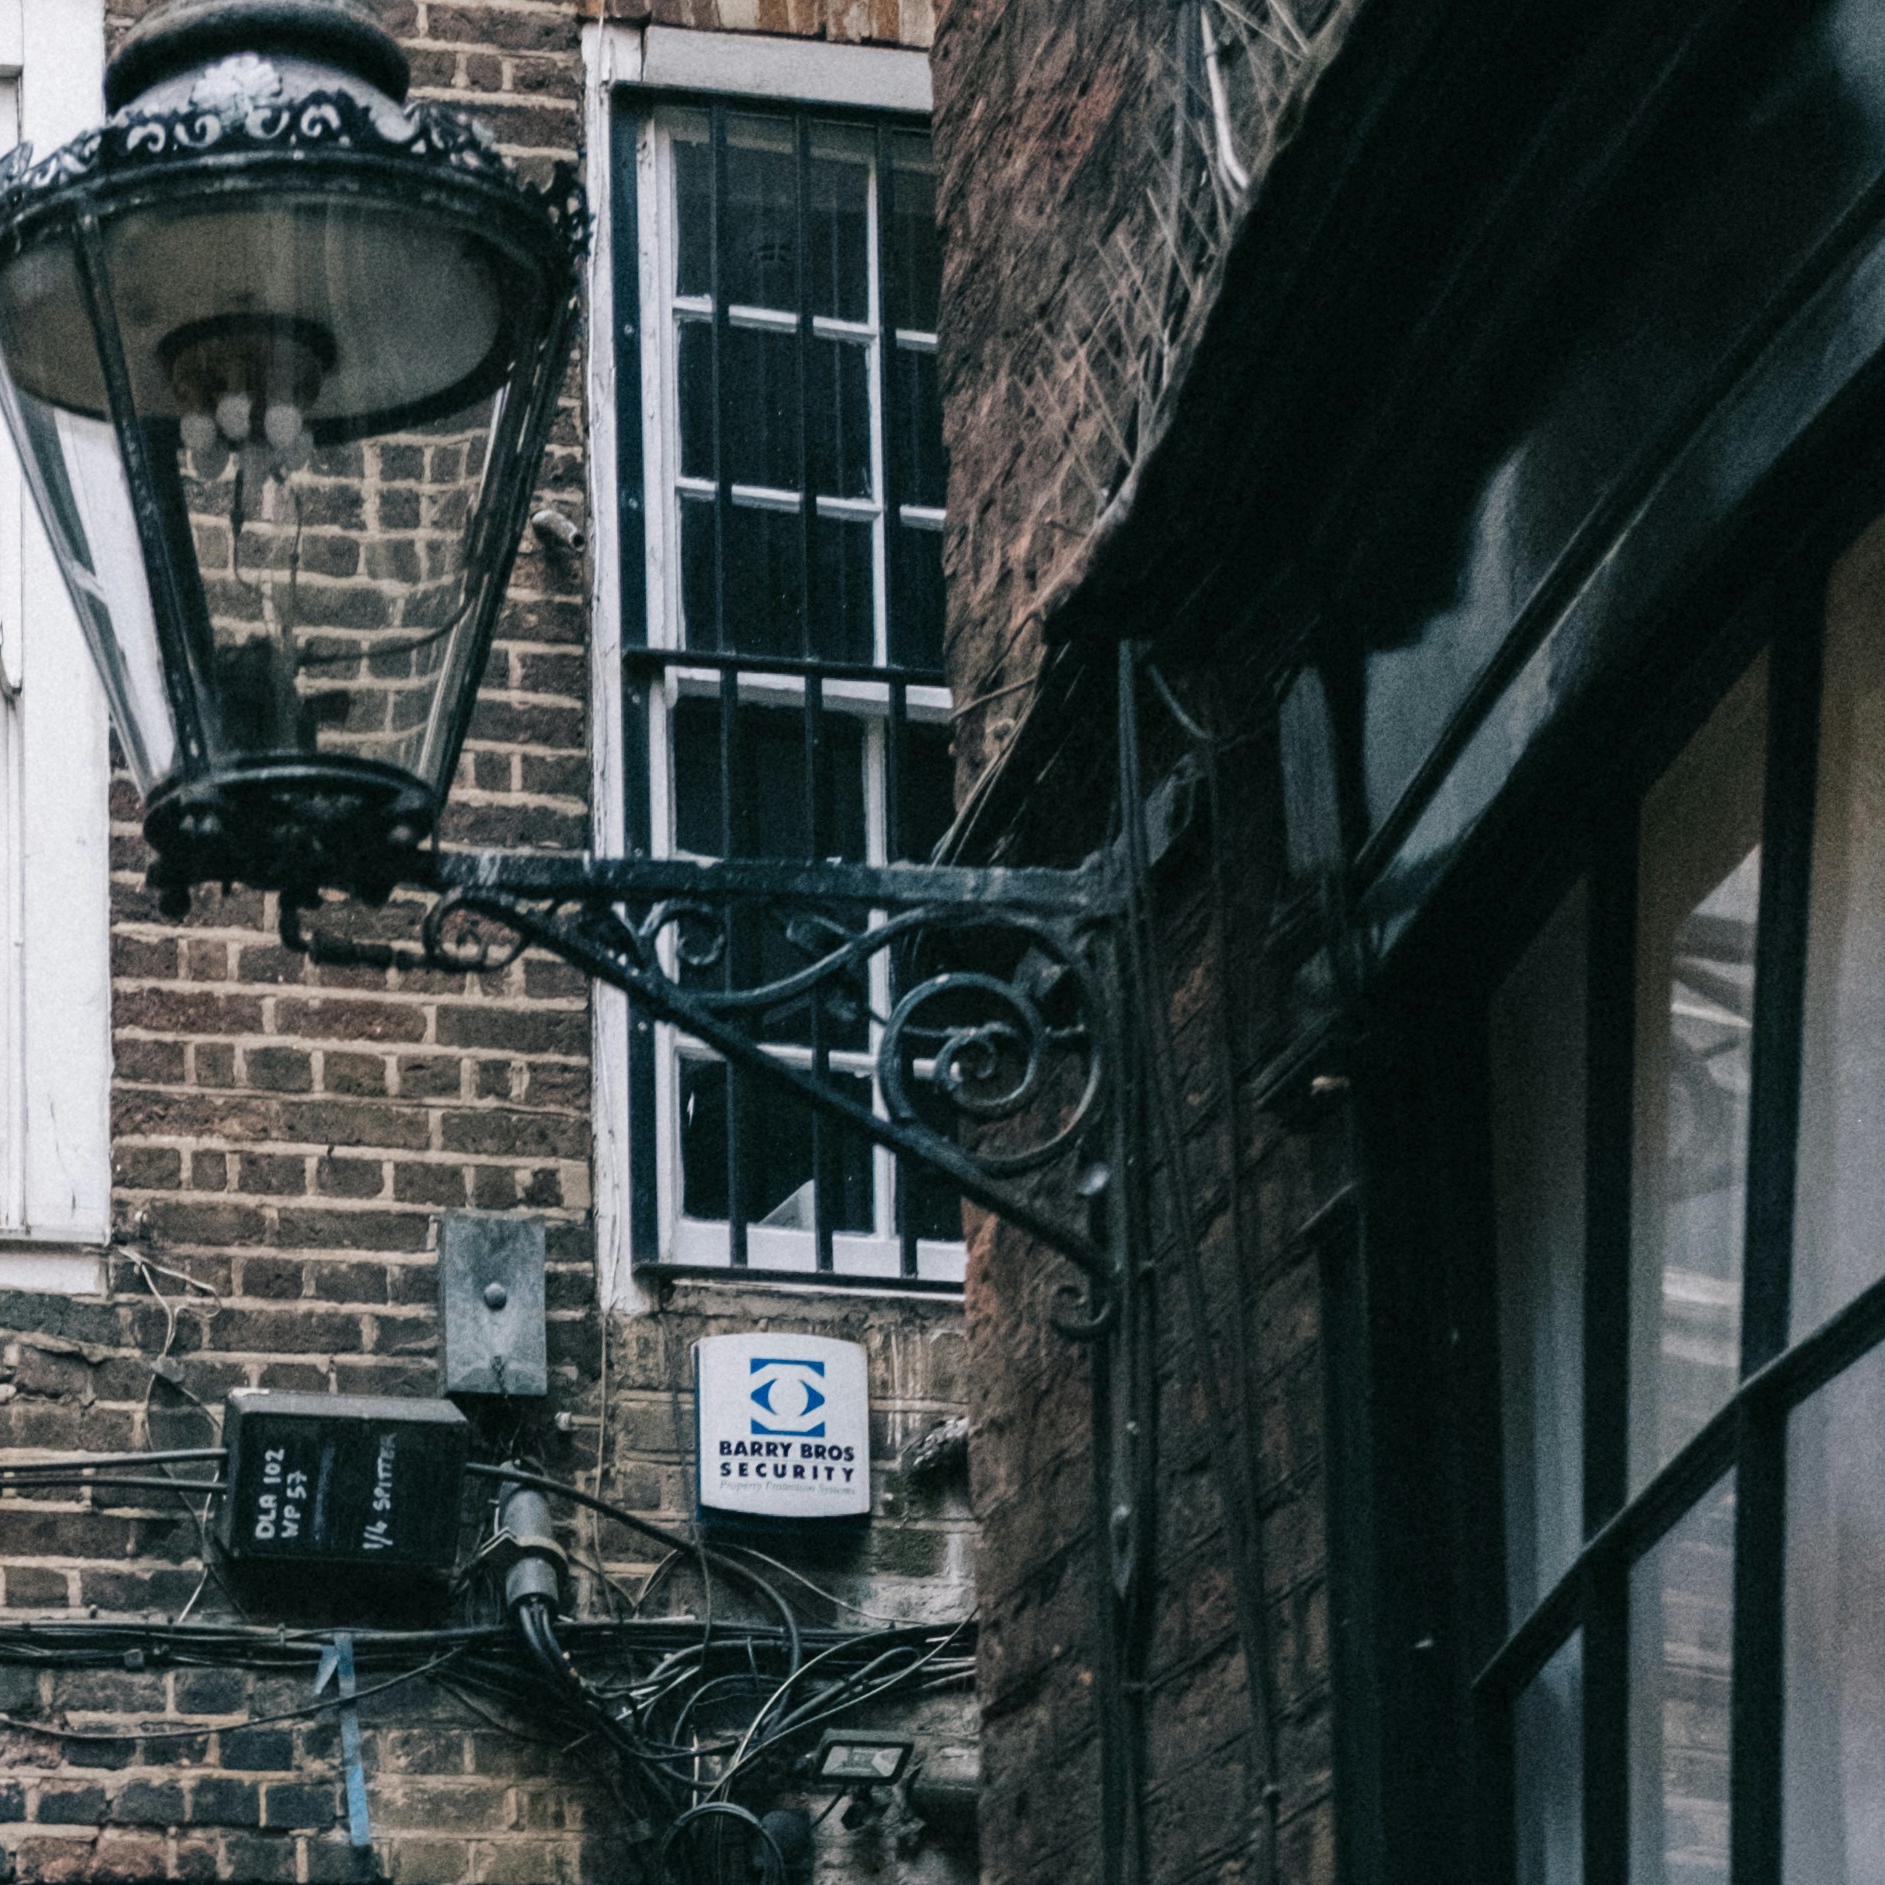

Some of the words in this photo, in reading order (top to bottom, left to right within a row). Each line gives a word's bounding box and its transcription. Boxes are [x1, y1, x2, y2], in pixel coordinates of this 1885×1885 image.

[263, 1448, 285, 1484] 102
[719, 1440, 793, 1458] BARRY
[800, 1443, 855, 1462] BROS
[287, 1470, 307, 1500] 57
[719, 1462, 855, 1483] SECURITY
[255, 1494, 277, 1540] DLA
[281, 1504, 301, 1538] WP
